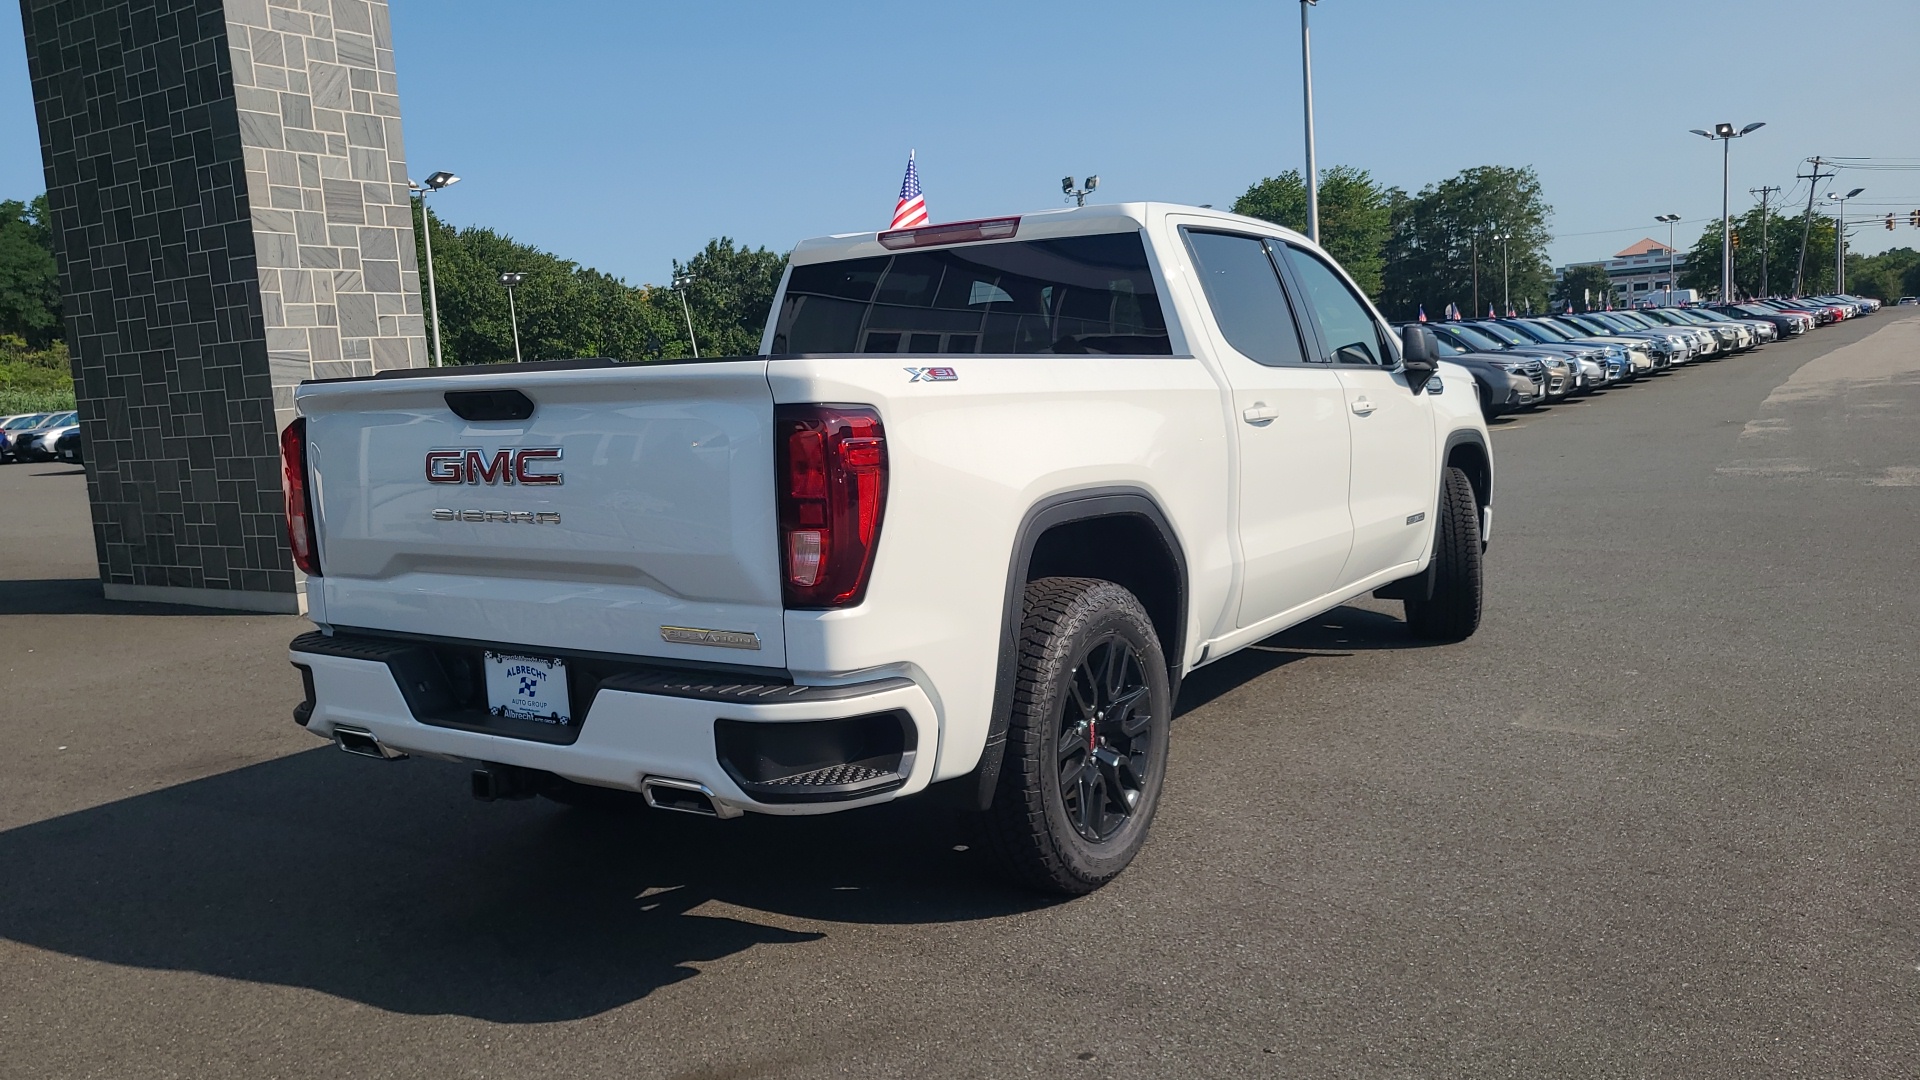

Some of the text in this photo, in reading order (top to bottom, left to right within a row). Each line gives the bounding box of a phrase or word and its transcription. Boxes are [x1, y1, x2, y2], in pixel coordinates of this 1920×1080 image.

[425, 447, 563, 486] GMC
[431, 508, 561, 524] SIERRA
[506, 665, 547, 681] ALBRECHT
[527, 700, 548, 709] GROUP
[504, 709, 535, 721] Albrecht
